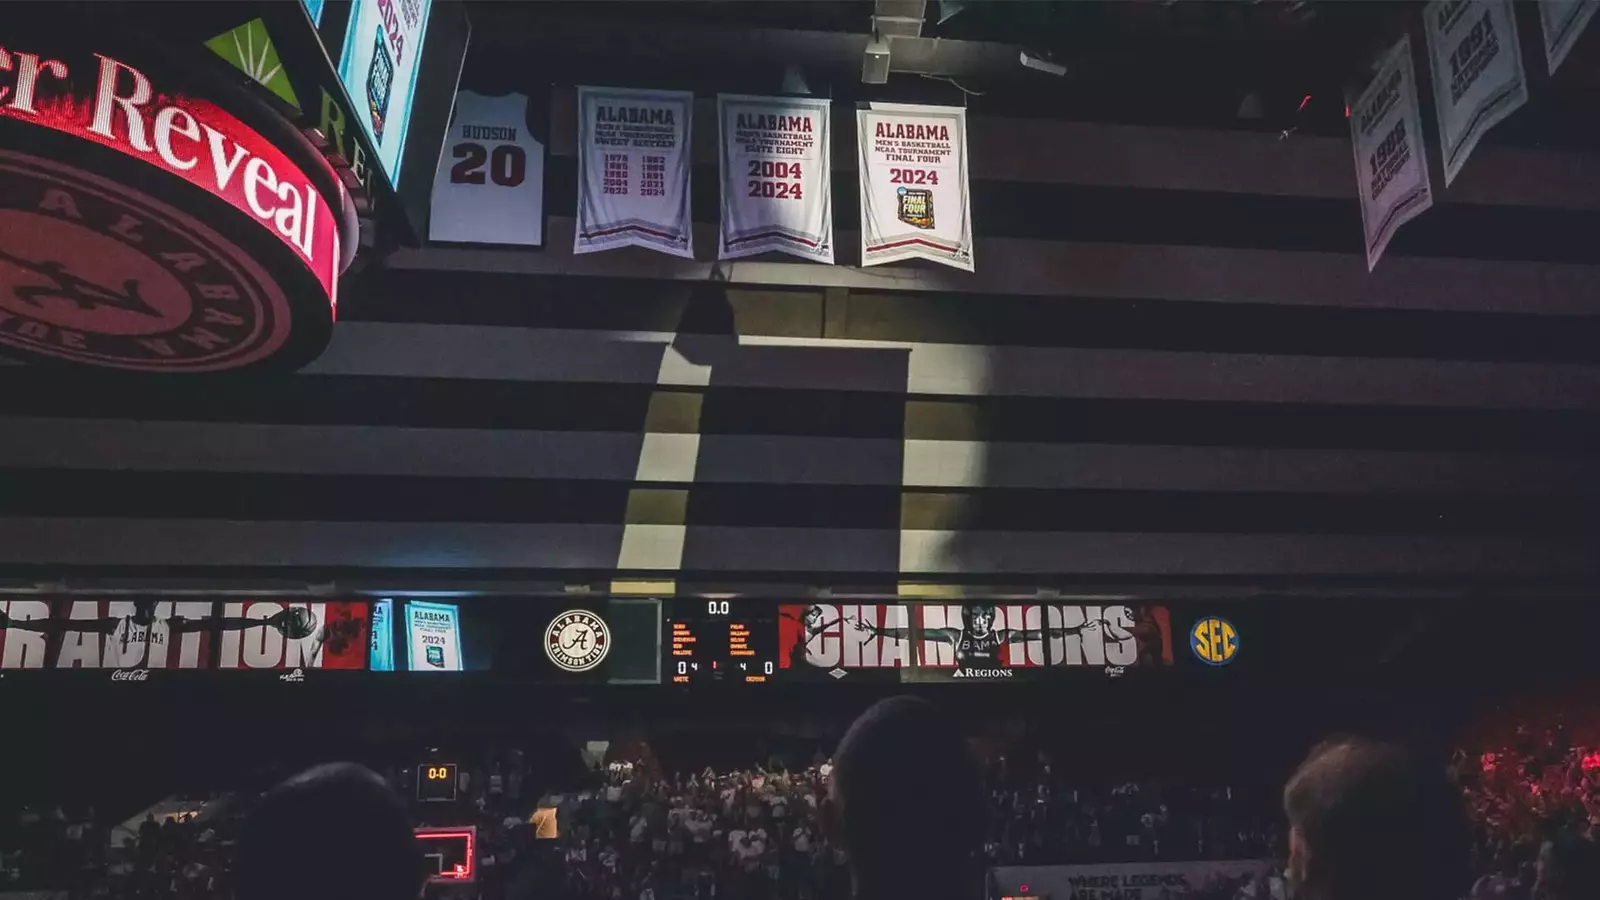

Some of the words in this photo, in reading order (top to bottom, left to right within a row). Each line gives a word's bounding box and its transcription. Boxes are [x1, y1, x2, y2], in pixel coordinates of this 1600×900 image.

[596, 105, 675, 125] ALABAMA
[736, 112, 812, 132] ALABAMA
[462, 124, 517, 141] HUDSON
[875, 122, 949, 141] ALABAMA
[760, 139, 814, 148] TOURNAMENT
[776, 146, 805, 155] EIGHT
[875, 139, 899, 147] MEN'S
[902, 140, 950, 149] BASKETBALL
[898, 147, 951, 156] TOURNAMENT
[87, 53, 313, 262] Reveal
[450, 142, 526, 187] 20
[886, 153, 914, 162] FINAL
[917, 155, 941, 163] FOUR
[748, 160, 802, 179] 2004
[890, 168, 939, 185] 2024
[640, 188, 665, 197] 2024
[748, 180, 803, 200] 2024
[903, 195, 926, 205] FINAL
[903, 204, 926, 215] FOUR
[414, 611, 450, 621] ALABAMA
[708, 601, 729, 615] 0.0
[552, 615, 603, 637] ALABAMA
[0, 601, 325, 668] RADITION
[422, 635, 446, 644] 2024
[1194, 619, 1236, 662] SEC
[551, 643, 586, 665] CRIMSON
[585, 643, 603, 662] TIDE
[678, 661, 687, 675] 0
[691, 662, 698, 671] 4
[740, 662, 746, 671] 4
[764, 661, 773, 675] 0
[966, 667, 1013, 678] REGIONS
[1068, 873, 1119, 888] WHERE
[1122, 872, 1187, 888] LEGENDS
